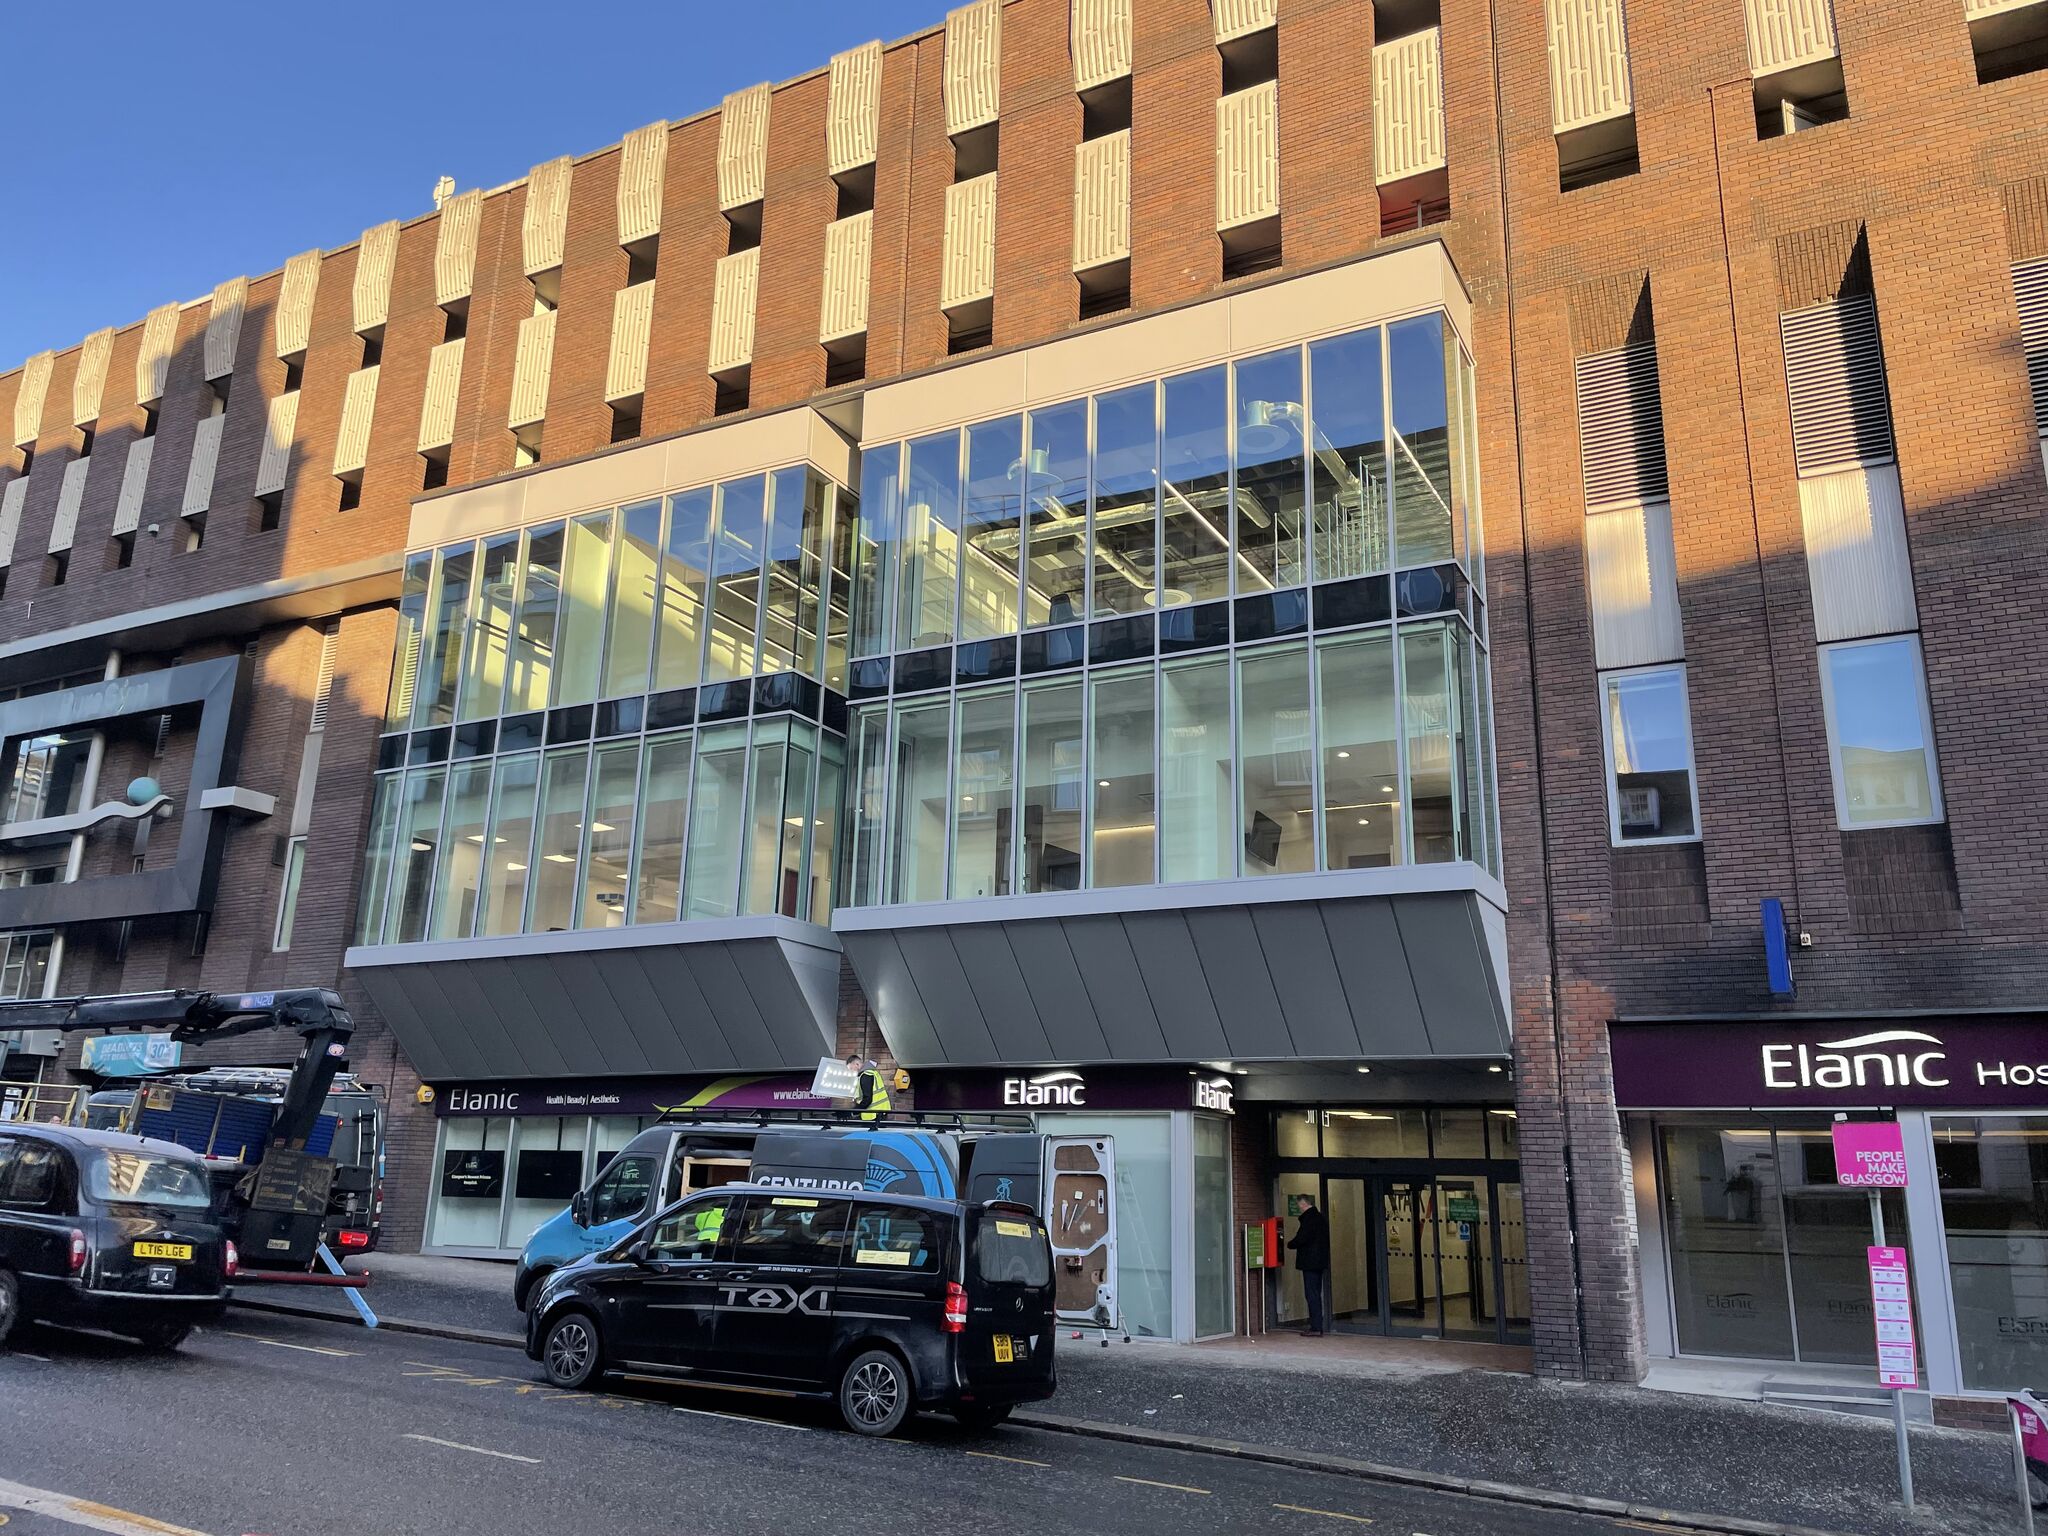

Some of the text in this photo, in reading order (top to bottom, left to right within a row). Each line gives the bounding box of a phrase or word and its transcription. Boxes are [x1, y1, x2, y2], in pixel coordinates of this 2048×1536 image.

[1761, 1043, 1950, 1088] Elanic
[450, 1088, 520, 1110] Elanic
[589, 1094, 620, 1104] Aesthetics
[1003, 1079, 1086, 1105] Elanic
[1197, 1081, 1234, 1111] Elanic
[1856, 1151, 1905, 1163] PEOPLE
[1868, 1163, 1906, 1174] MAKE
[1840, 1173, 1906, 1186] GLASGOW
[140, 1244, 185, 1257] LT16 LGE
[719, 1284, 829, 1314] TAXI
